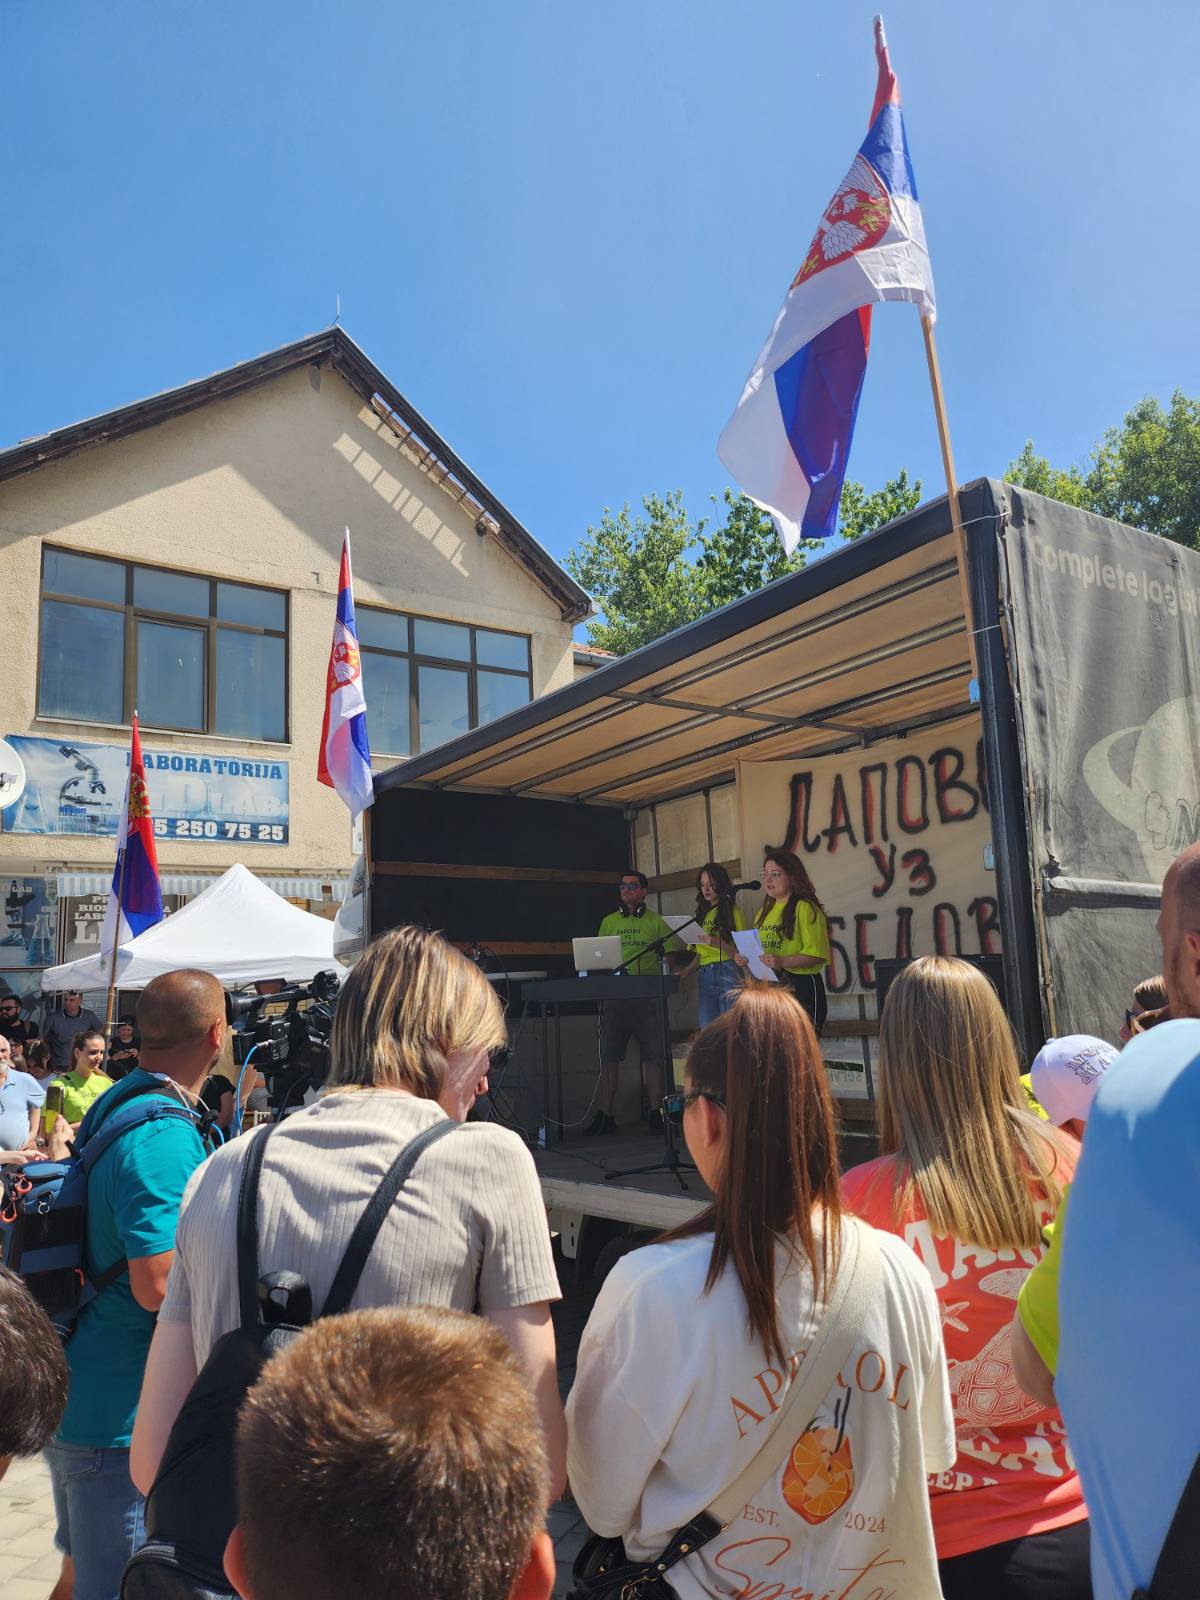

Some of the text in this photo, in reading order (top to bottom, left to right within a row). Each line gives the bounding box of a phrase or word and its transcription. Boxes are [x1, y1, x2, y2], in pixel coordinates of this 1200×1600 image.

[1031, 536, 1138, 597] complete
[126, 752, 282, 779] ABORATORIJA
[176, 820, 218, 837] 250
[224, 823, 251, 839] 75
[258, 825, 284, 840] 25
[869, 843, 936, 898] УЗ
[743, 1503, 886, 1533] EST. 2024
